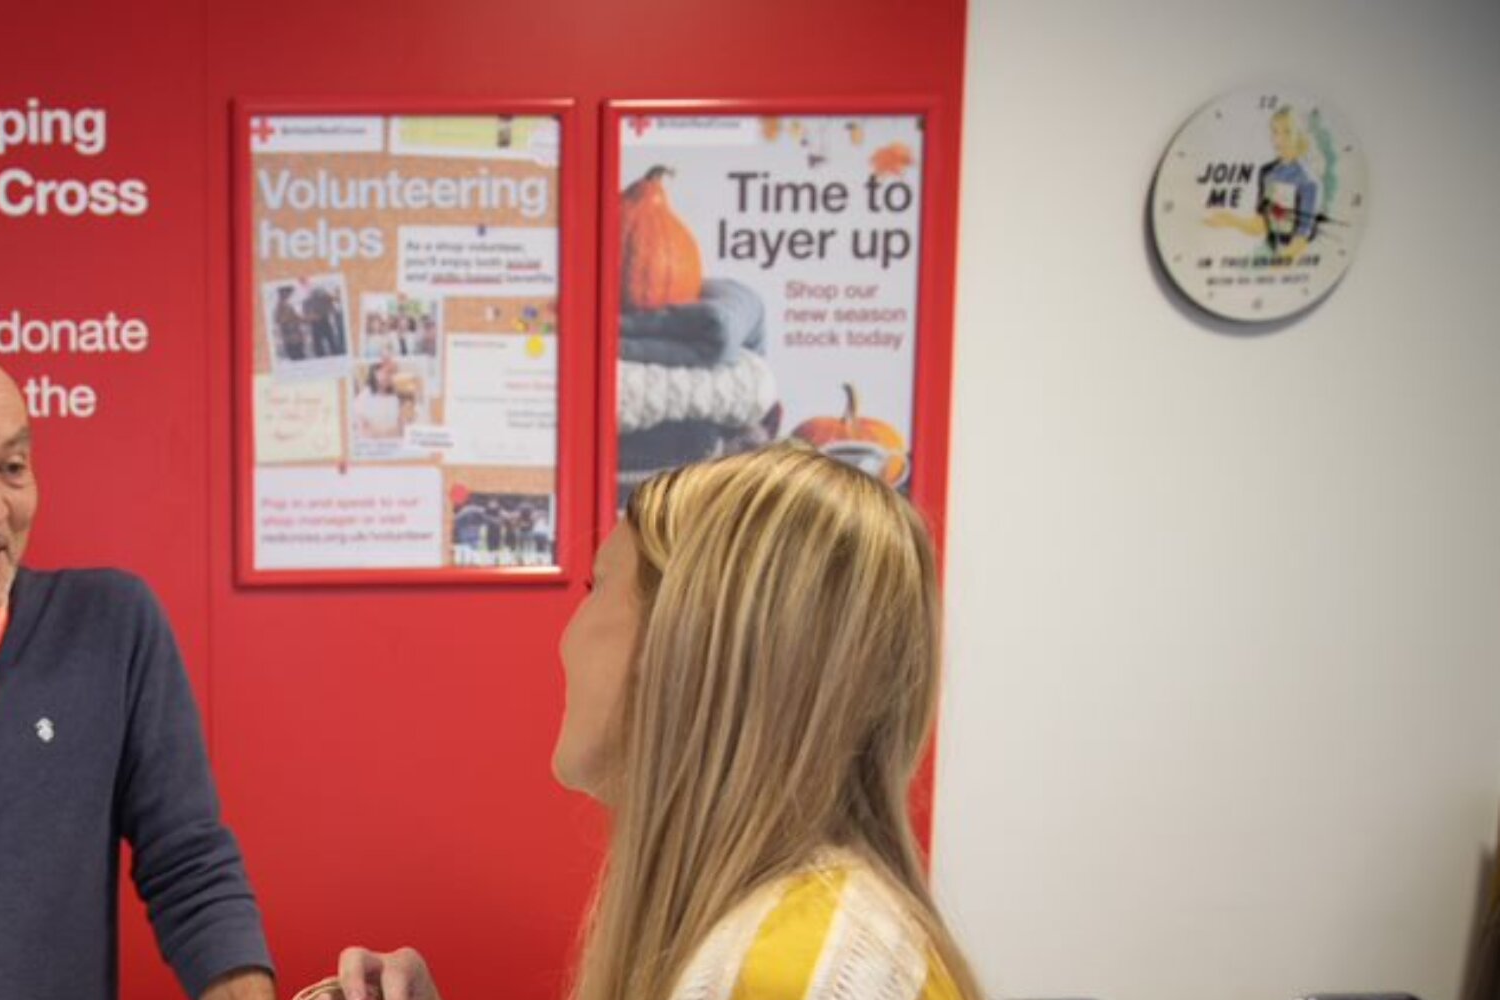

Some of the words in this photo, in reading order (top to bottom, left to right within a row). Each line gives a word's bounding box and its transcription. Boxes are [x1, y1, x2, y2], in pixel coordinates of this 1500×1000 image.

[1197, 163, 1254, 184] JOIN
[258, 168, 548, 217] Volunteering
[727, 171, 849, 214] Time
[865, 173, 912, 214] to
[1205, 188, 1242, 208] ME
[258, 221, 384, 266] helps
[718, 218, 837, 270] layer
[851, 228, 911, 270] up
[784, 281, 839, 303] Shop
[844, 284, 879, 300] our
[783, 307, 828, 323] new
[833, 307, 907, 323] season
[783, 330, 839, 347] stock
[846, 330, 905, 351] today
[24, 377, 96, 419] the
